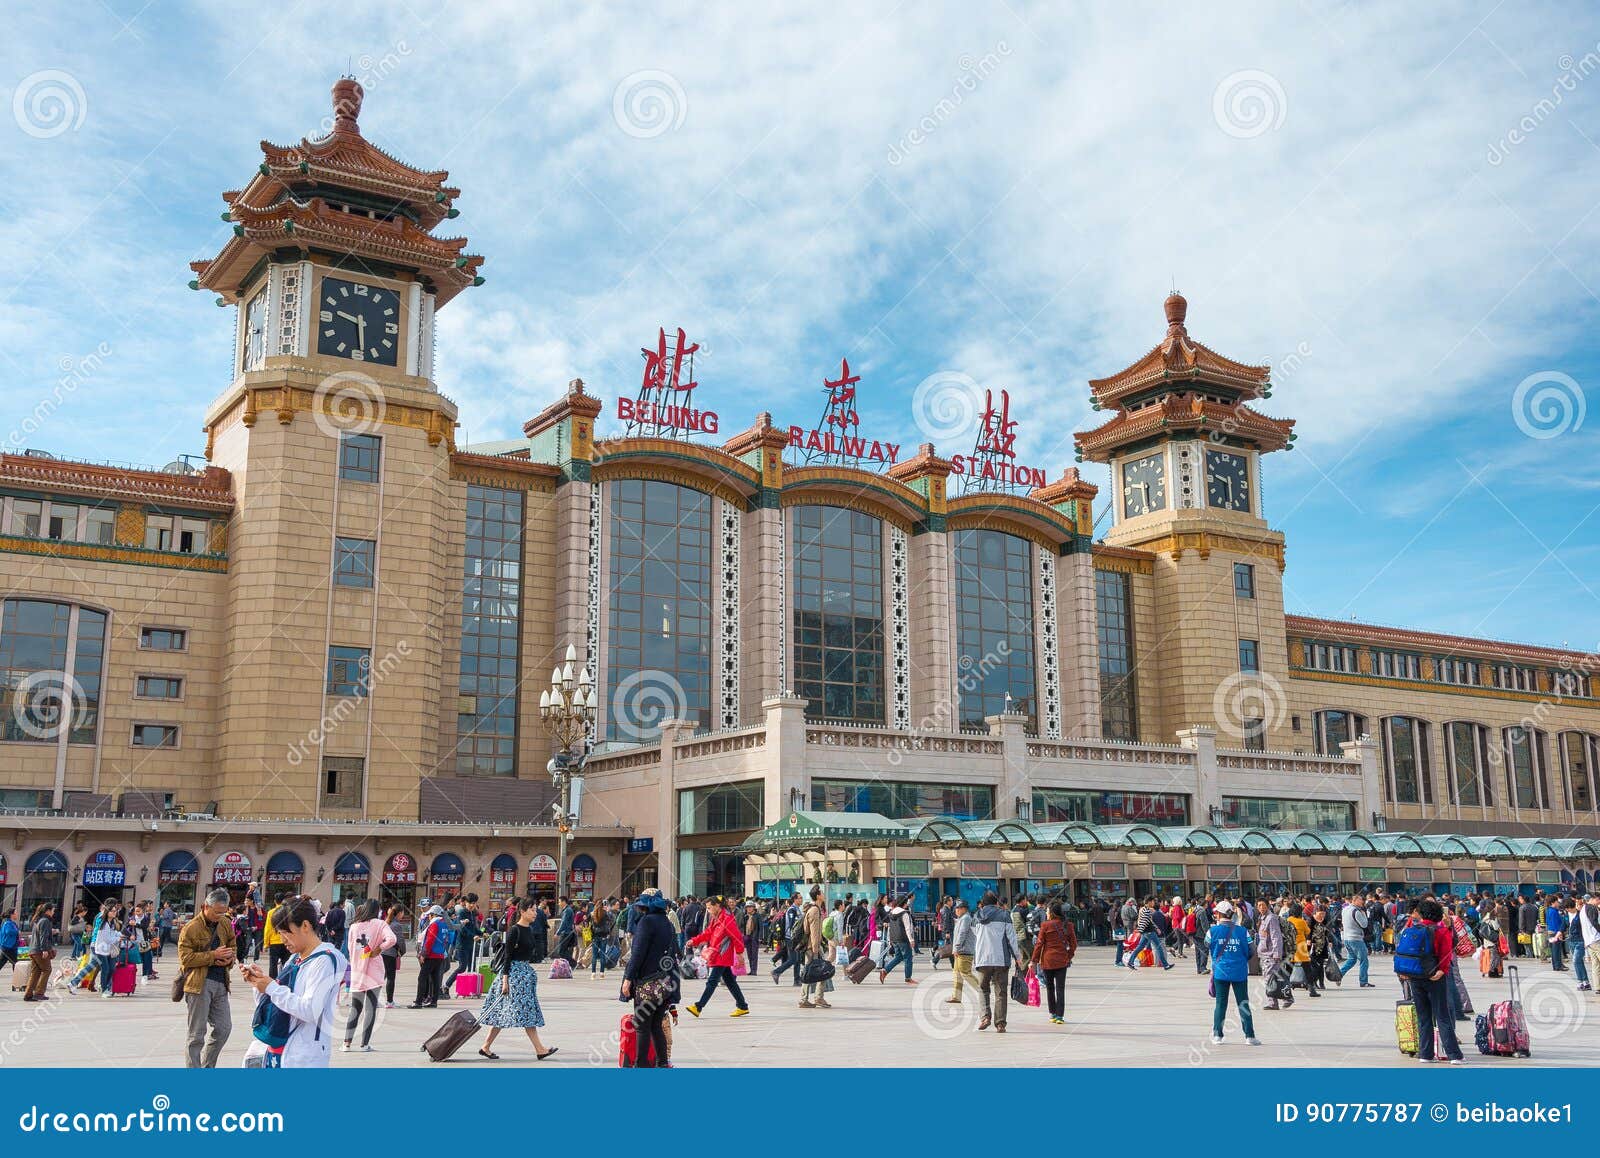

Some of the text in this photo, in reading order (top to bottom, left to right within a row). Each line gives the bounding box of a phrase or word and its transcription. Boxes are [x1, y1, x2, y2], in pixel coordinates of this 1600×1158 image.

[353, 284, 368, 296] 12
[320, 310, 333, 322] 9
[385, 322, 398, 334] 3
[351, 349, 364, 361] 6
[641, 326, 1018, 460] 北 京 站
[617, 396, 1047, 489] BEIJING RAILWAY STATION
[85, 869, 124, 884] 站区寄存
[215, 869, 251, 882] 红螺食品
[493, 870, 514, 882] 超市
[574, 871, 593, 882] 超市
